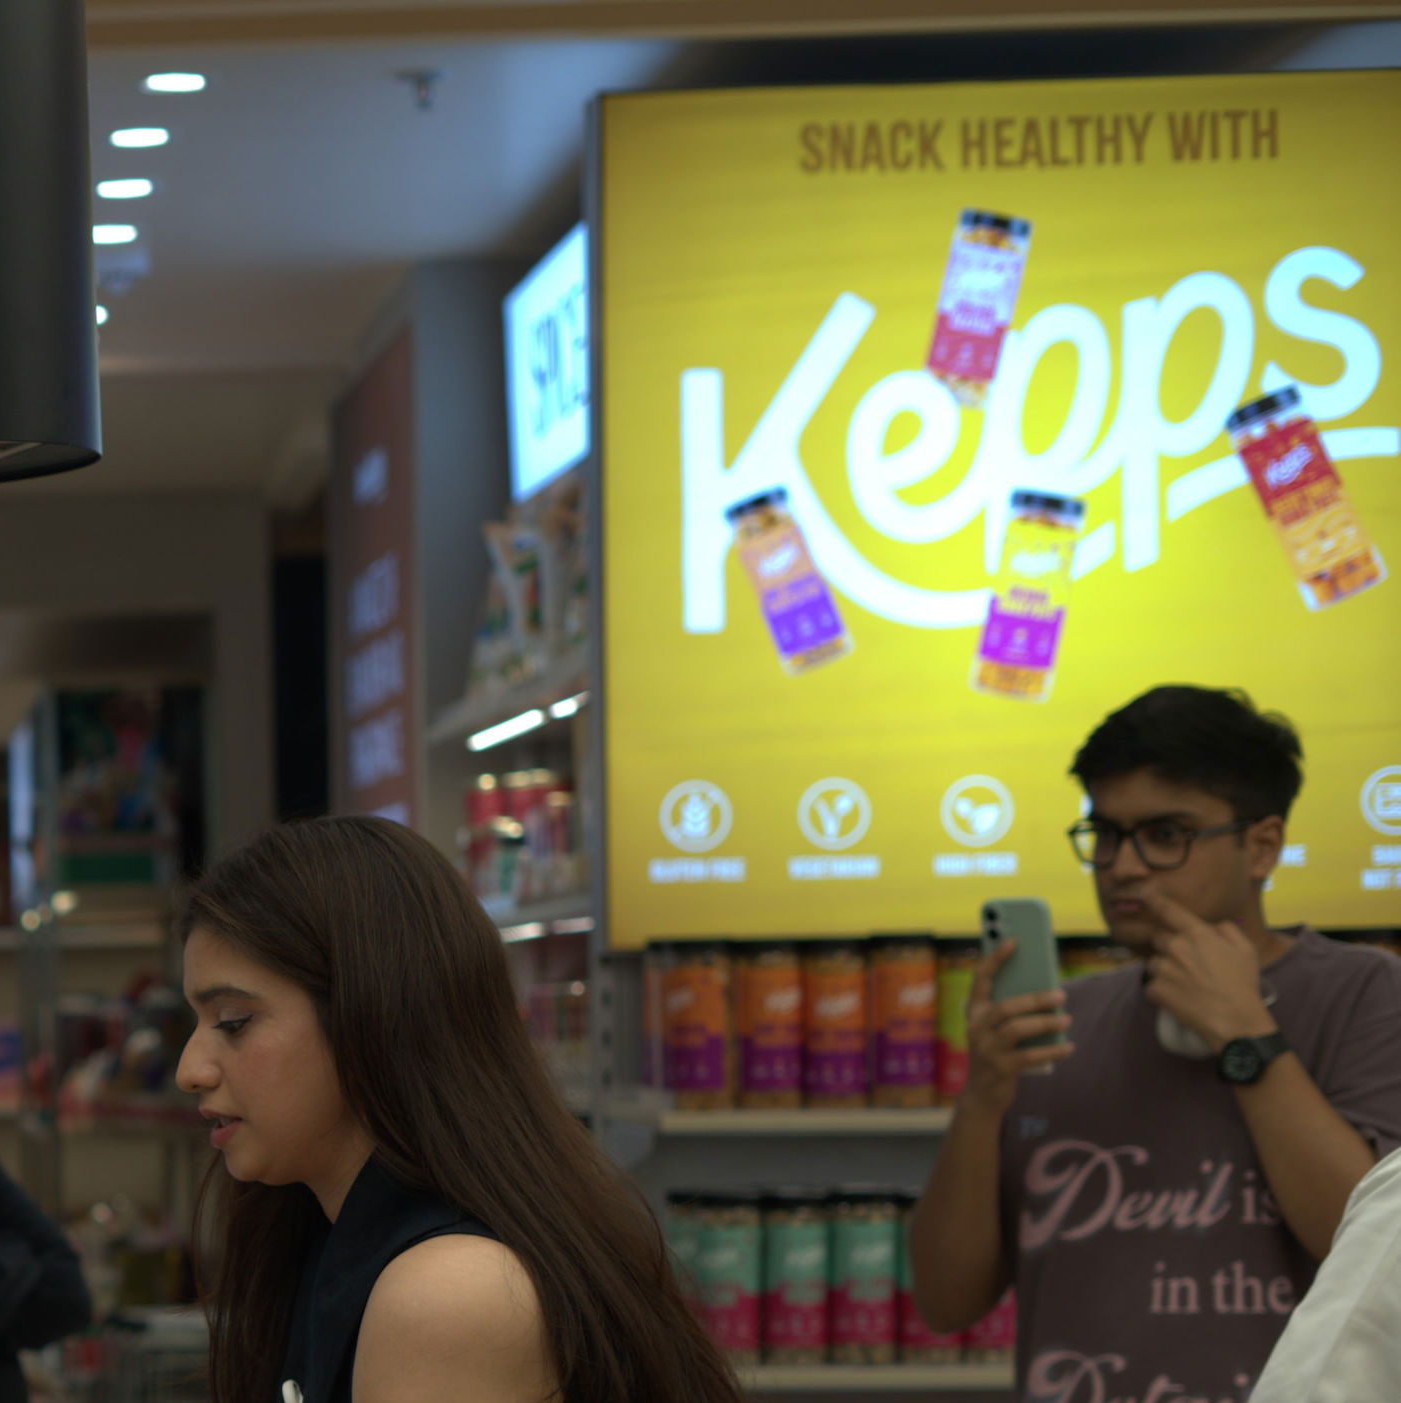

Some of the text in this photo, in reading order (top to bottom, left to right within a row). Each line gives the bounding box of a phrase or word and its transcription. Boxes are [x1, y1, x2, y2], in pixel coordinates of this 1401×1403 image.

[799, 108, 1281, 174] SNACK HEALTHY WITH
[679, 245, 1383, 634] Kepps
[1019, 1139, 1233, 1250] Devil
[1150, 1261, 1294, 1315] in the
